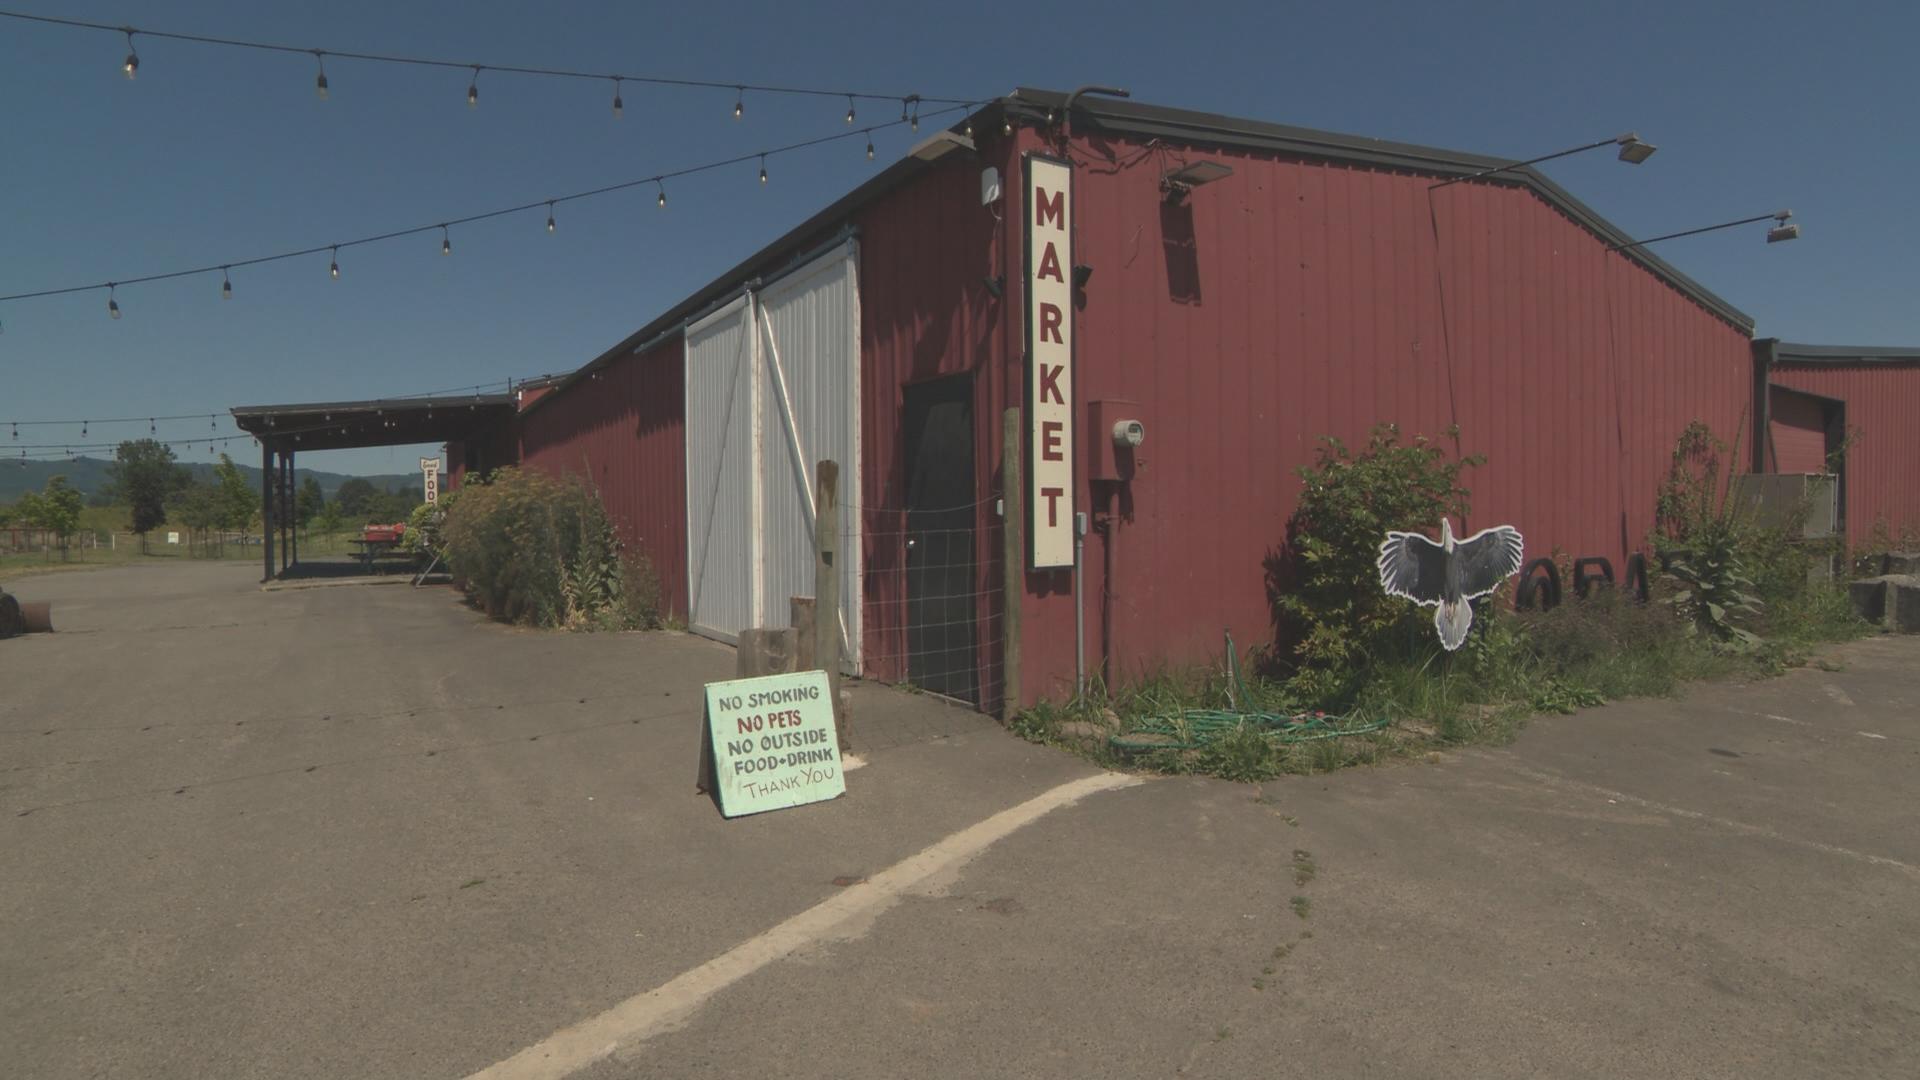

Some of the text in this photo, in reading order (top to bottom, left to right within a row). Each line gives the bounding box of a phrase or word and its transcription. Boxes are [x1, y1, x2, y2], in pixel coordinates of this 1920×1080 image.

[1035, 186, 1065, 527] MARKET
[427, 470, 435, 504] FOO
[719, 686, 819, 712] NO SMOKING
[737, 710, 802, 734] NO PETS
[728, 728, 827, 757] NO OUTSIDE
[744, 767, 834, 798] THANK YOU
